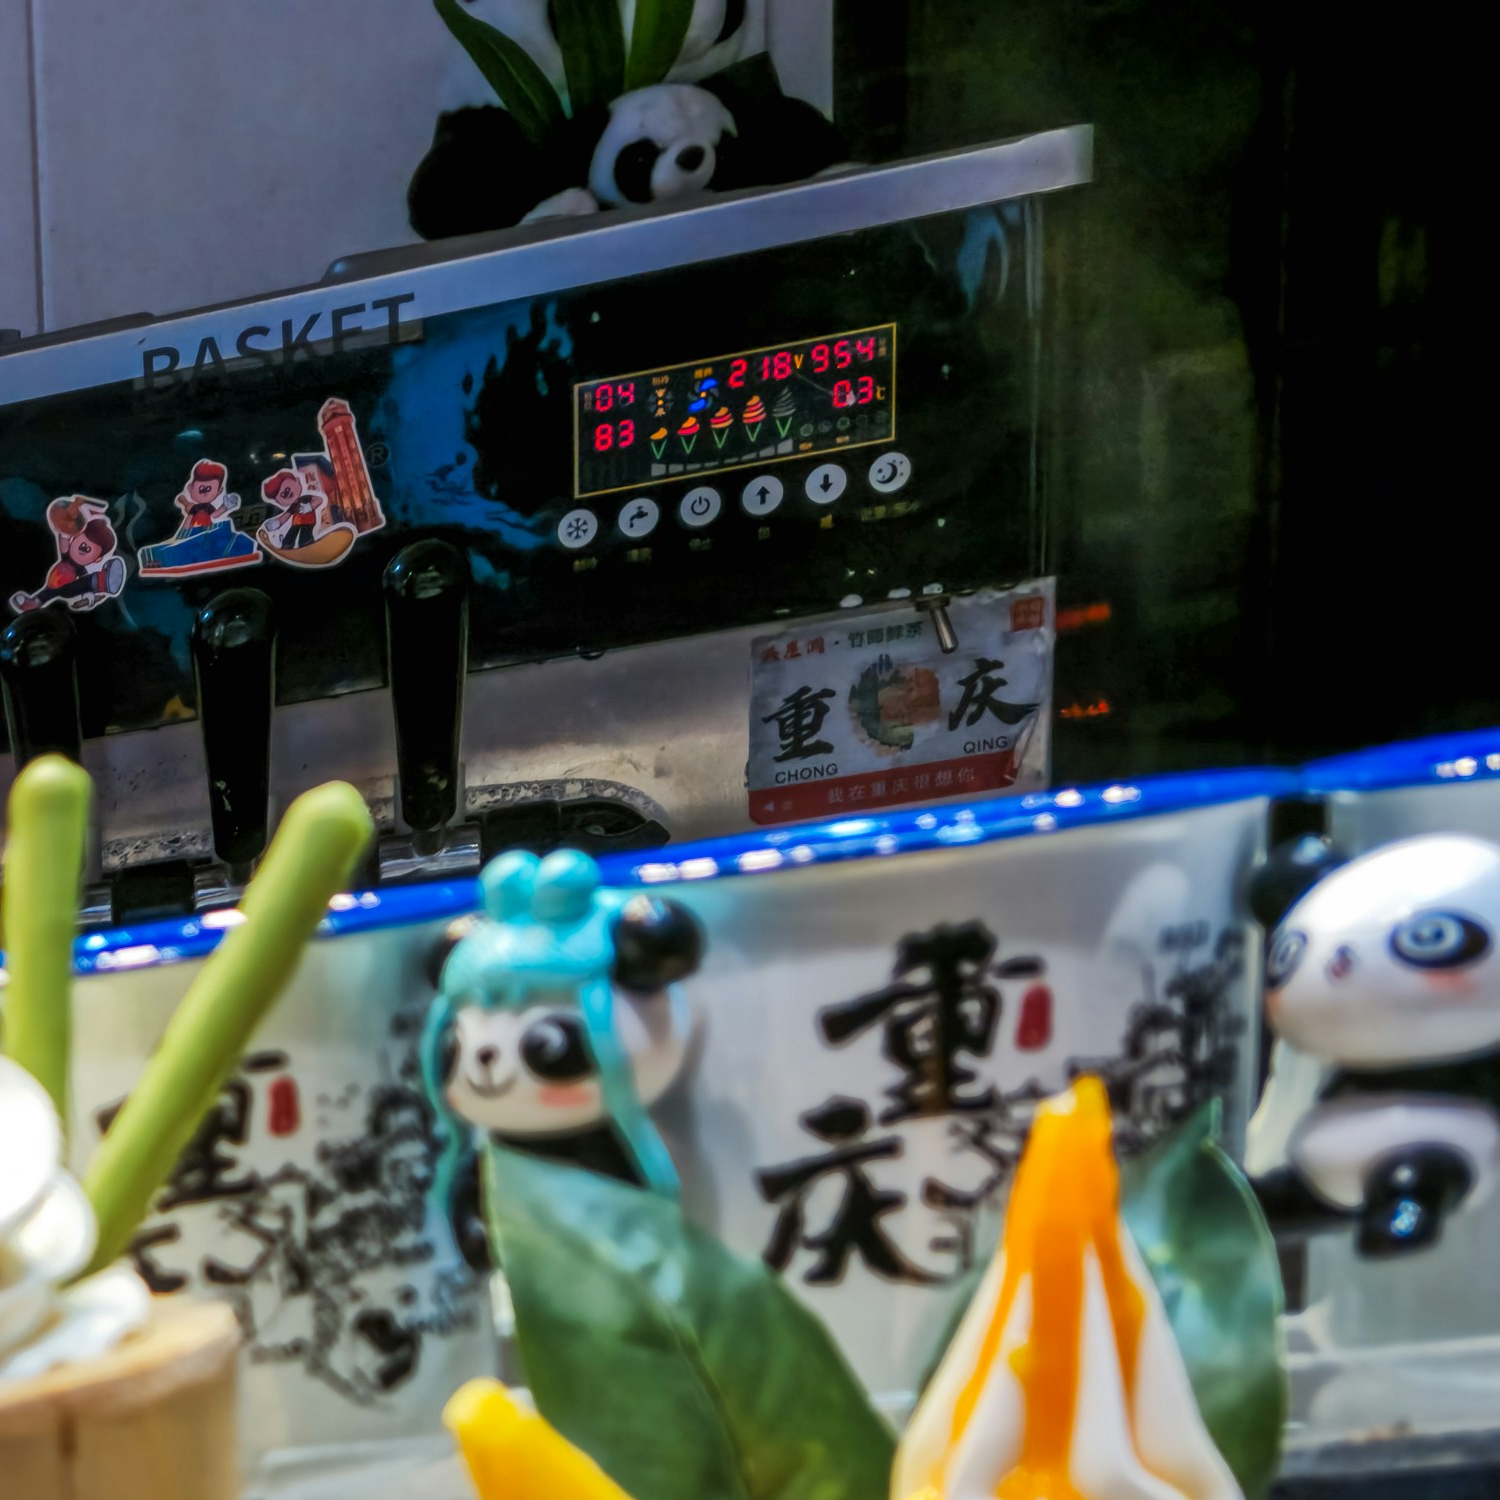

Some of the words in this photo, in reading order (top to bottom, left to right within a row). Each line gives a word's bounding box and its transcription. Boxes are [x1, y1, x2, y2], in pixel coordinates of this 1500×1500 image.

[595, 382, 636, 412] 04
[811, 336, 875, 373] 954
[595, 420, 635, 451] 83
[761, 685, 836, 763] 重
[947, 657, 1041, 732] 庆
[774, 762, 839, 786] CHONG
[962, 735, 1009, 755] QING
[827, 766, 977, 805] 我在重庆很想你
